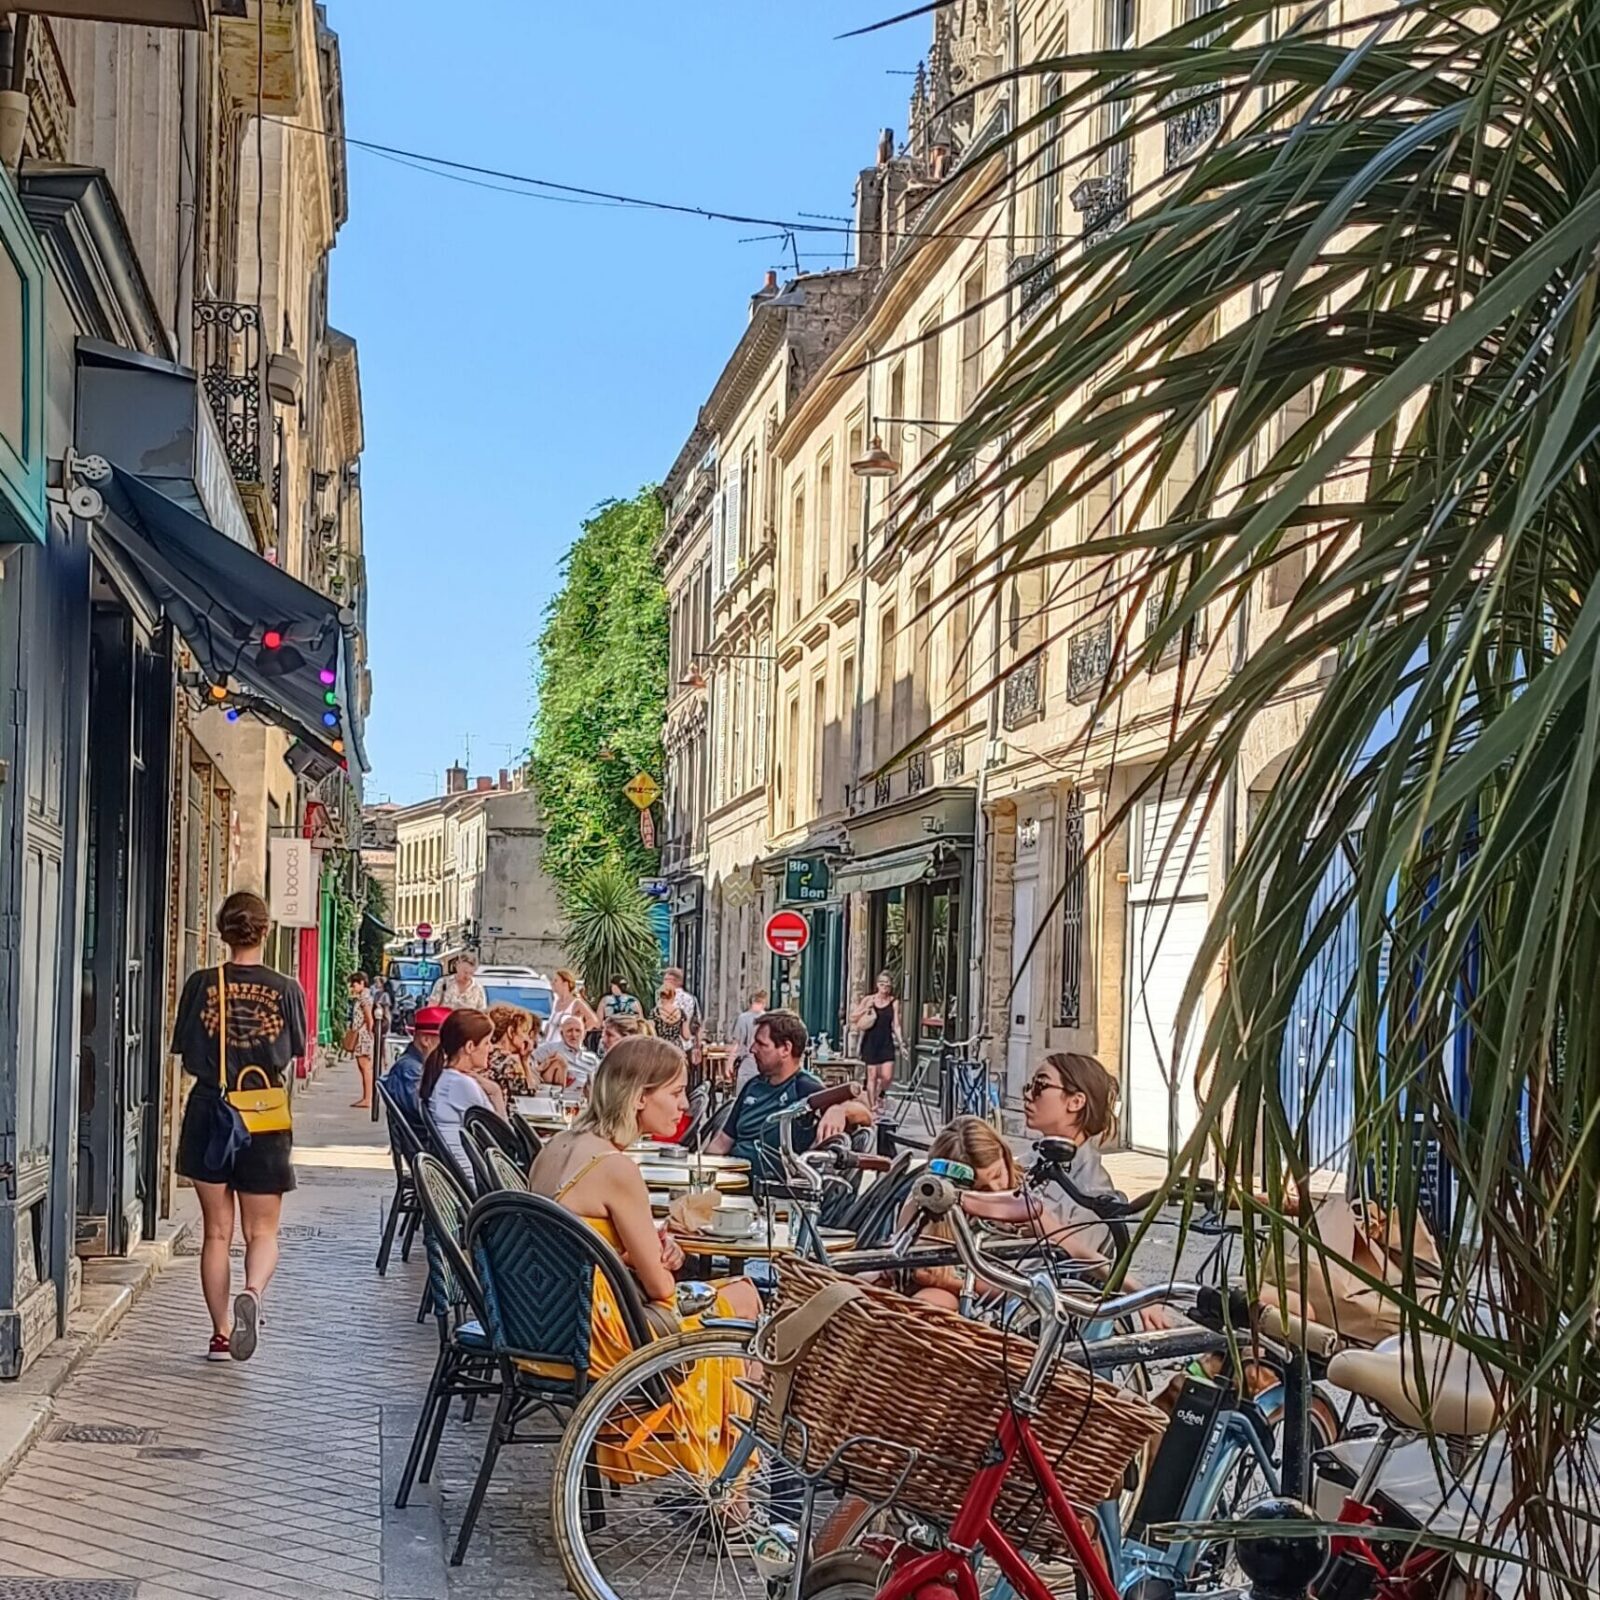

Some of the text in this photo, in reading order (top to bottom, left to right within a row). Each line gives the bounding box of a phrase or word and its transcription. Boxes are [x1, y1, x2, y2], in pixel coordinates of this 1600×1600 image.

[788, 860, 810, 872] Bio
[283, 847, 299, 916] la bocca
[800, 886, 825, 898] Bon
